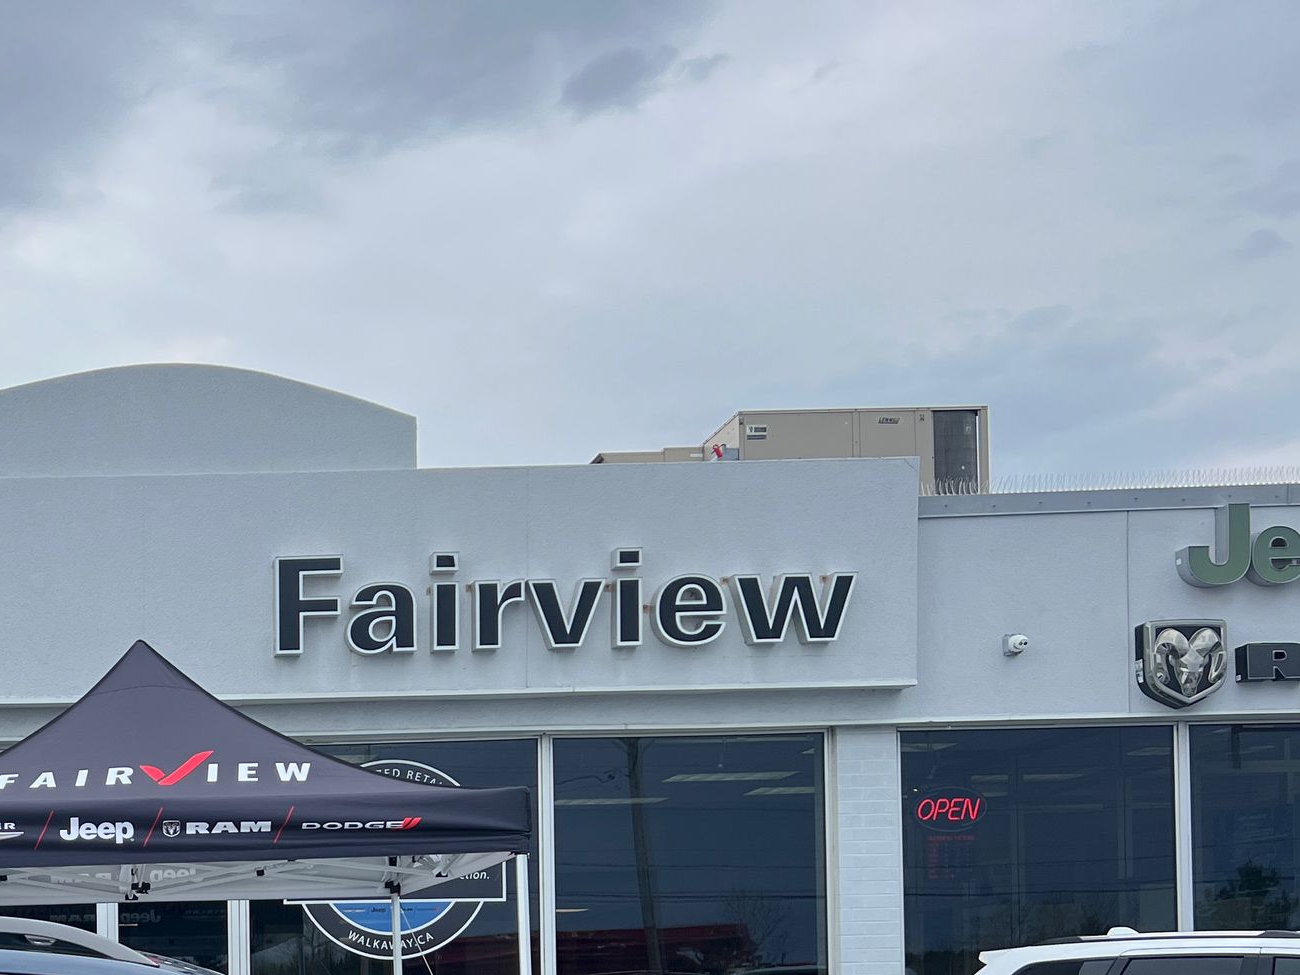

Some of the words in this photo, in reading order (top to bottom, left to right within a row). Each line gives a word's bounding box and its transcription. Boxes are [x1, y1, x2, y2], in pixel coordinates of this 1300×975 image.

[273, 546, 858, 657] Fairview
[917, 798, 981, 820] OPEN
[59, 817, 134, 843] Jeep
[185, 821, 272, 834] RAM
[301, 821, 404, 830] DODGE
